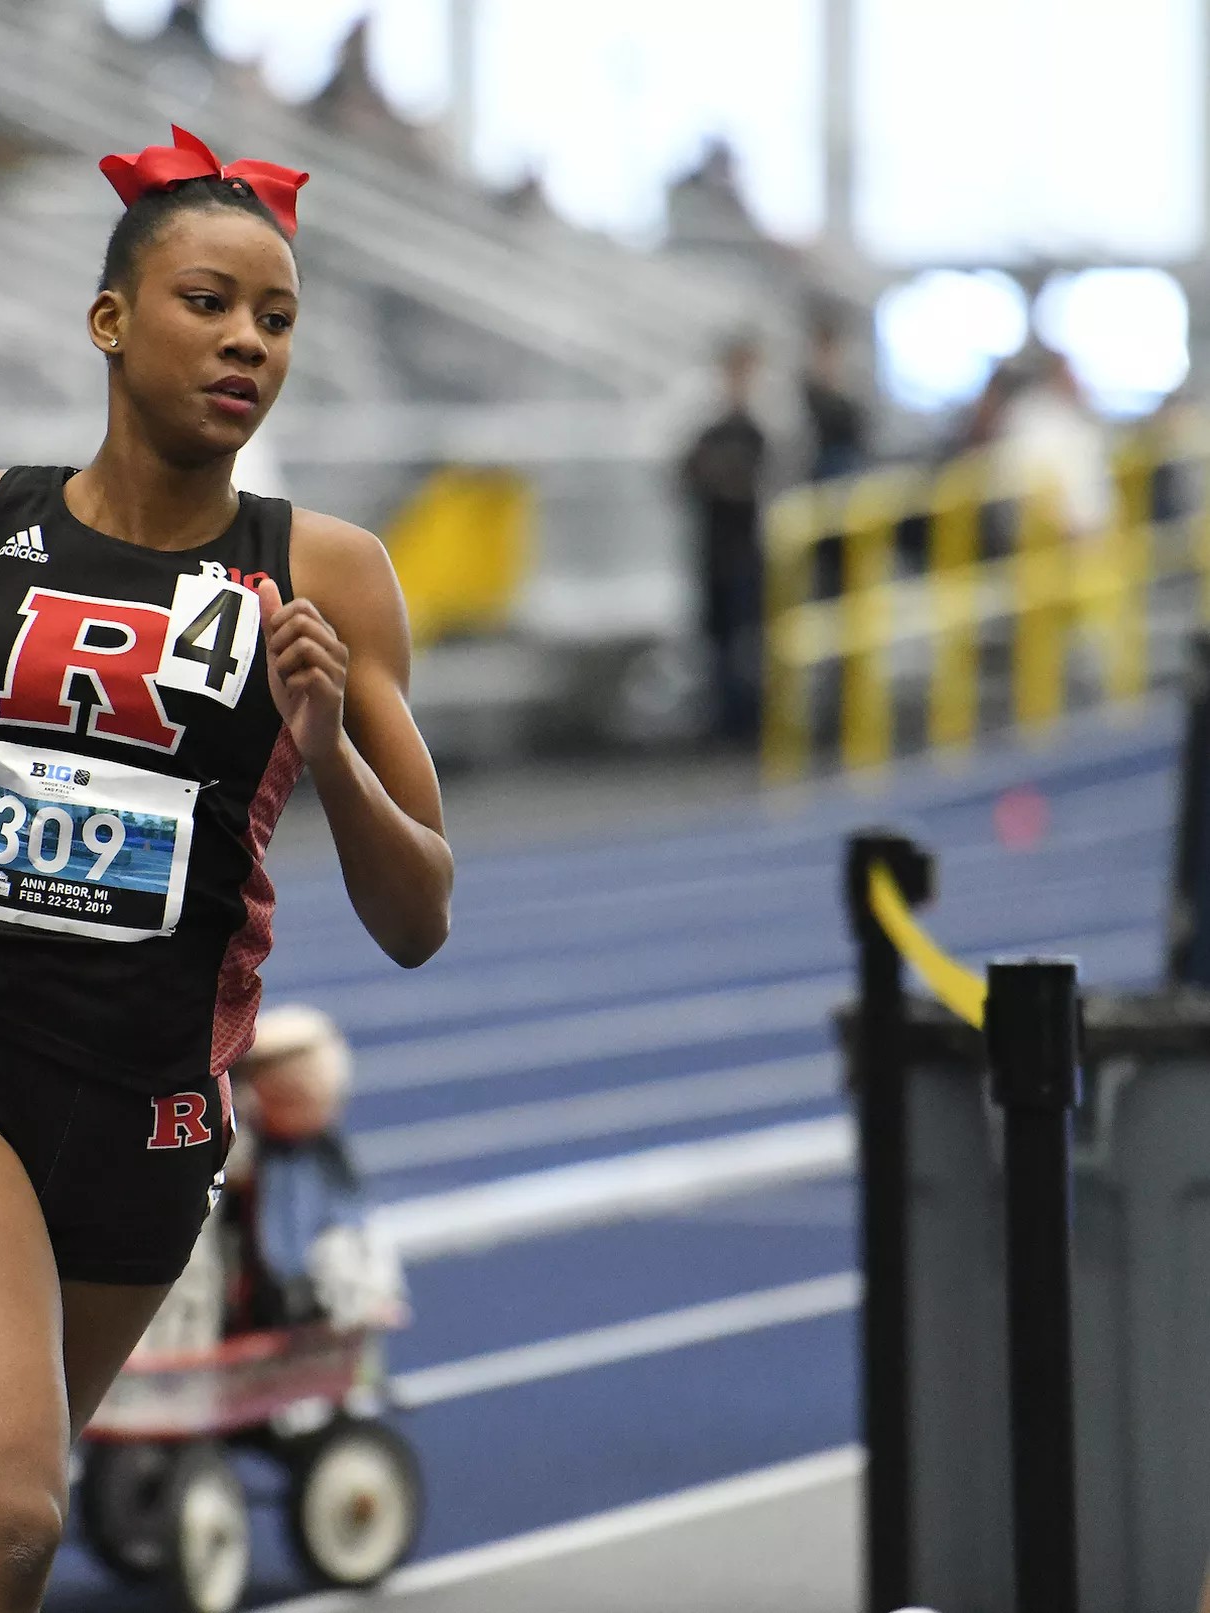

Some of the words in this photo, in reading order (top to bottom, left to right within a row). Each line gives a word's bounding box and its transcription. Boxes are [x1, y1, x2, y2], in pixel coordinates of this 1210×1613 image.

[172, 588, 243, 693] 4
[19, 890, 45, 904] FEB.
[47, 895, 83, 911] 22-23,
[84, 901, 112, 915] 2019
[20, 877, 46, 891] ANN
[48, 881, 92, 899] ARBOR,
[93, 888, 109, 901] MI
[146, 1091, 212, 1150] R
